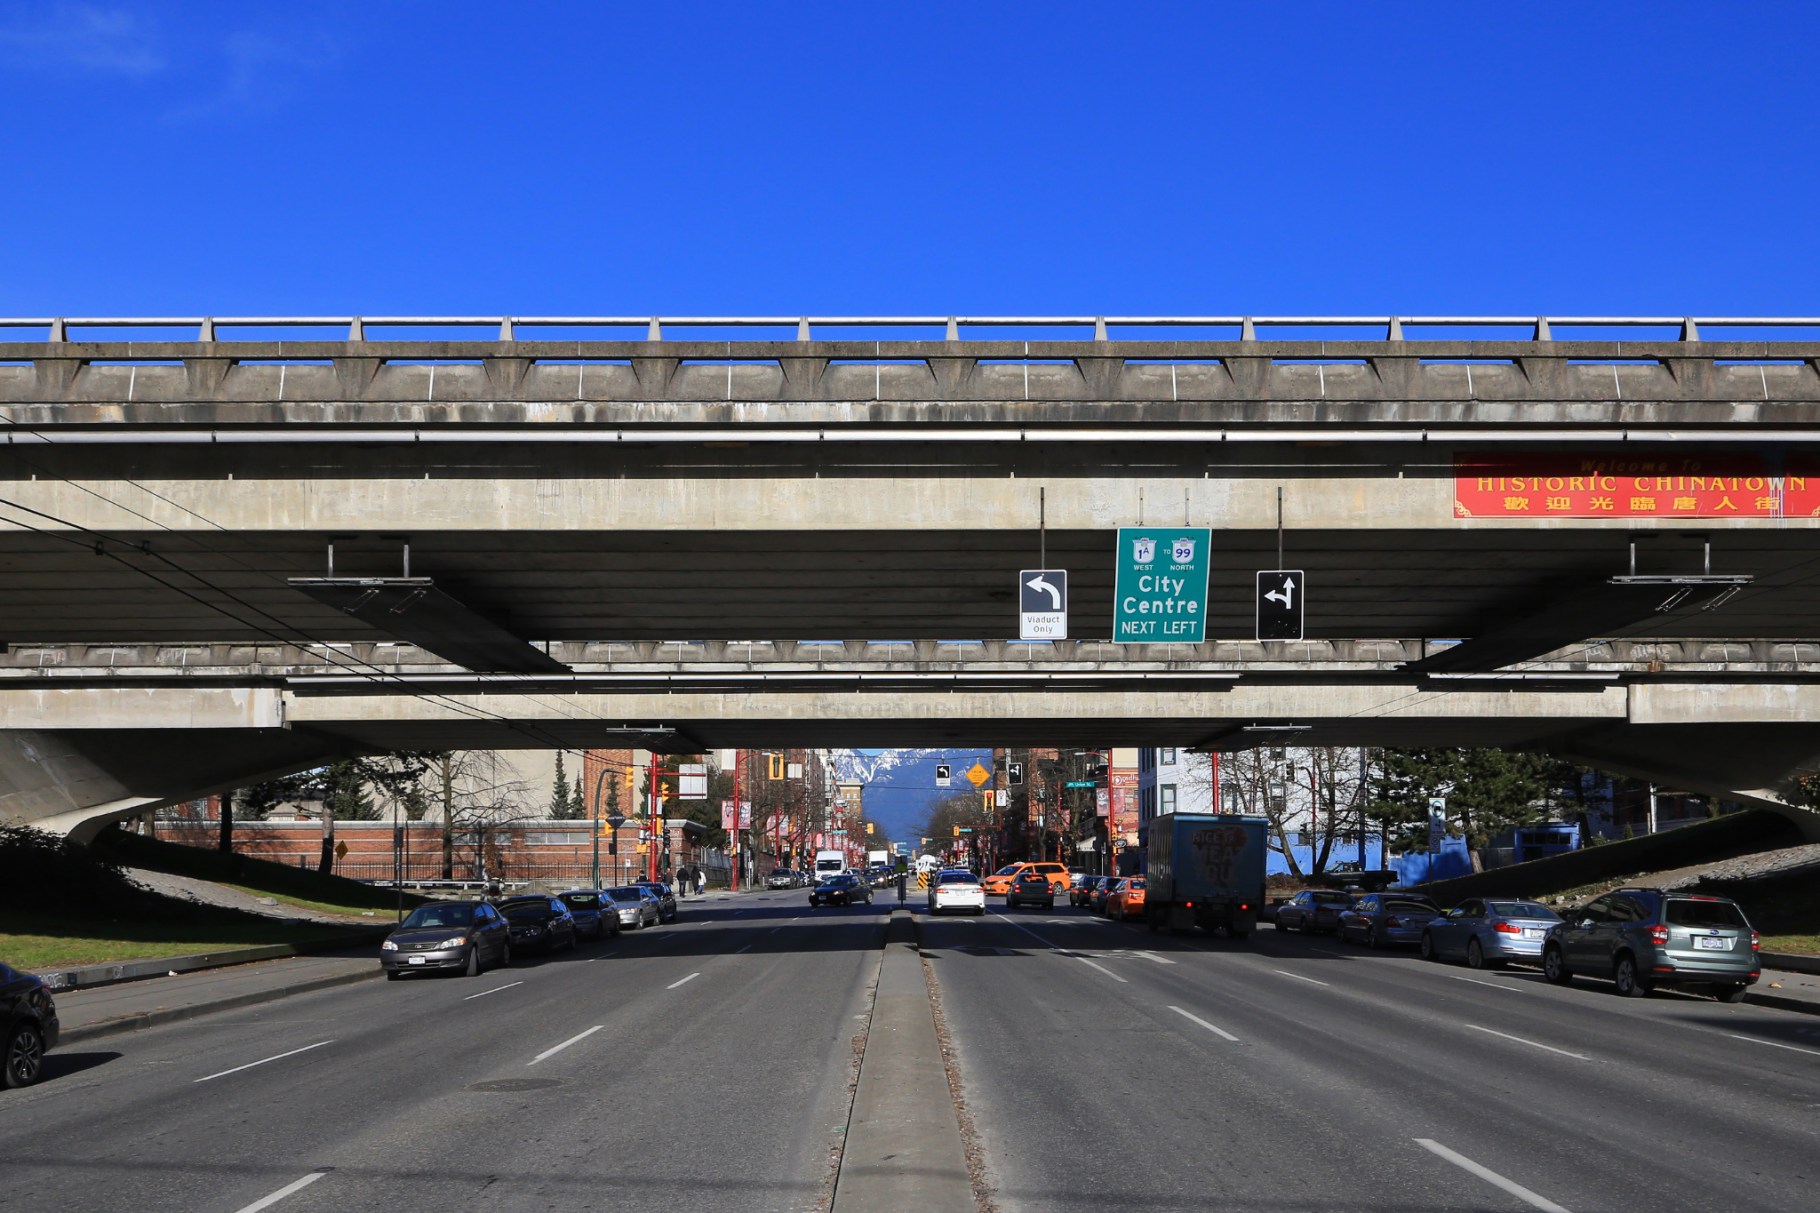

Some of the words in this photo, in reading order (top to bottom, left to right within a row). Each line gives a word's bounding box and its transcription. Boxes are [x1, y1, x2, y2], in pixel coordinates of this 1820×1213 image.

[1476, 476, 1618, 492] HISTORIC
[1634, 476, 1807, 492] CHINATOWN
[1175, 548, 1191, 558] 99
[1138, 575, 1185, 596] City
[1123, 596, 1199, 614] Centre
[1027, 615, 1060, 624] Viaduct
[1033, 625, 1053, 634] Only
[1121, 621, 1156, 635] NEXT
[1163, 621, 1198, 635] LEFT
[1192, 831, 1220, 843] NICE
